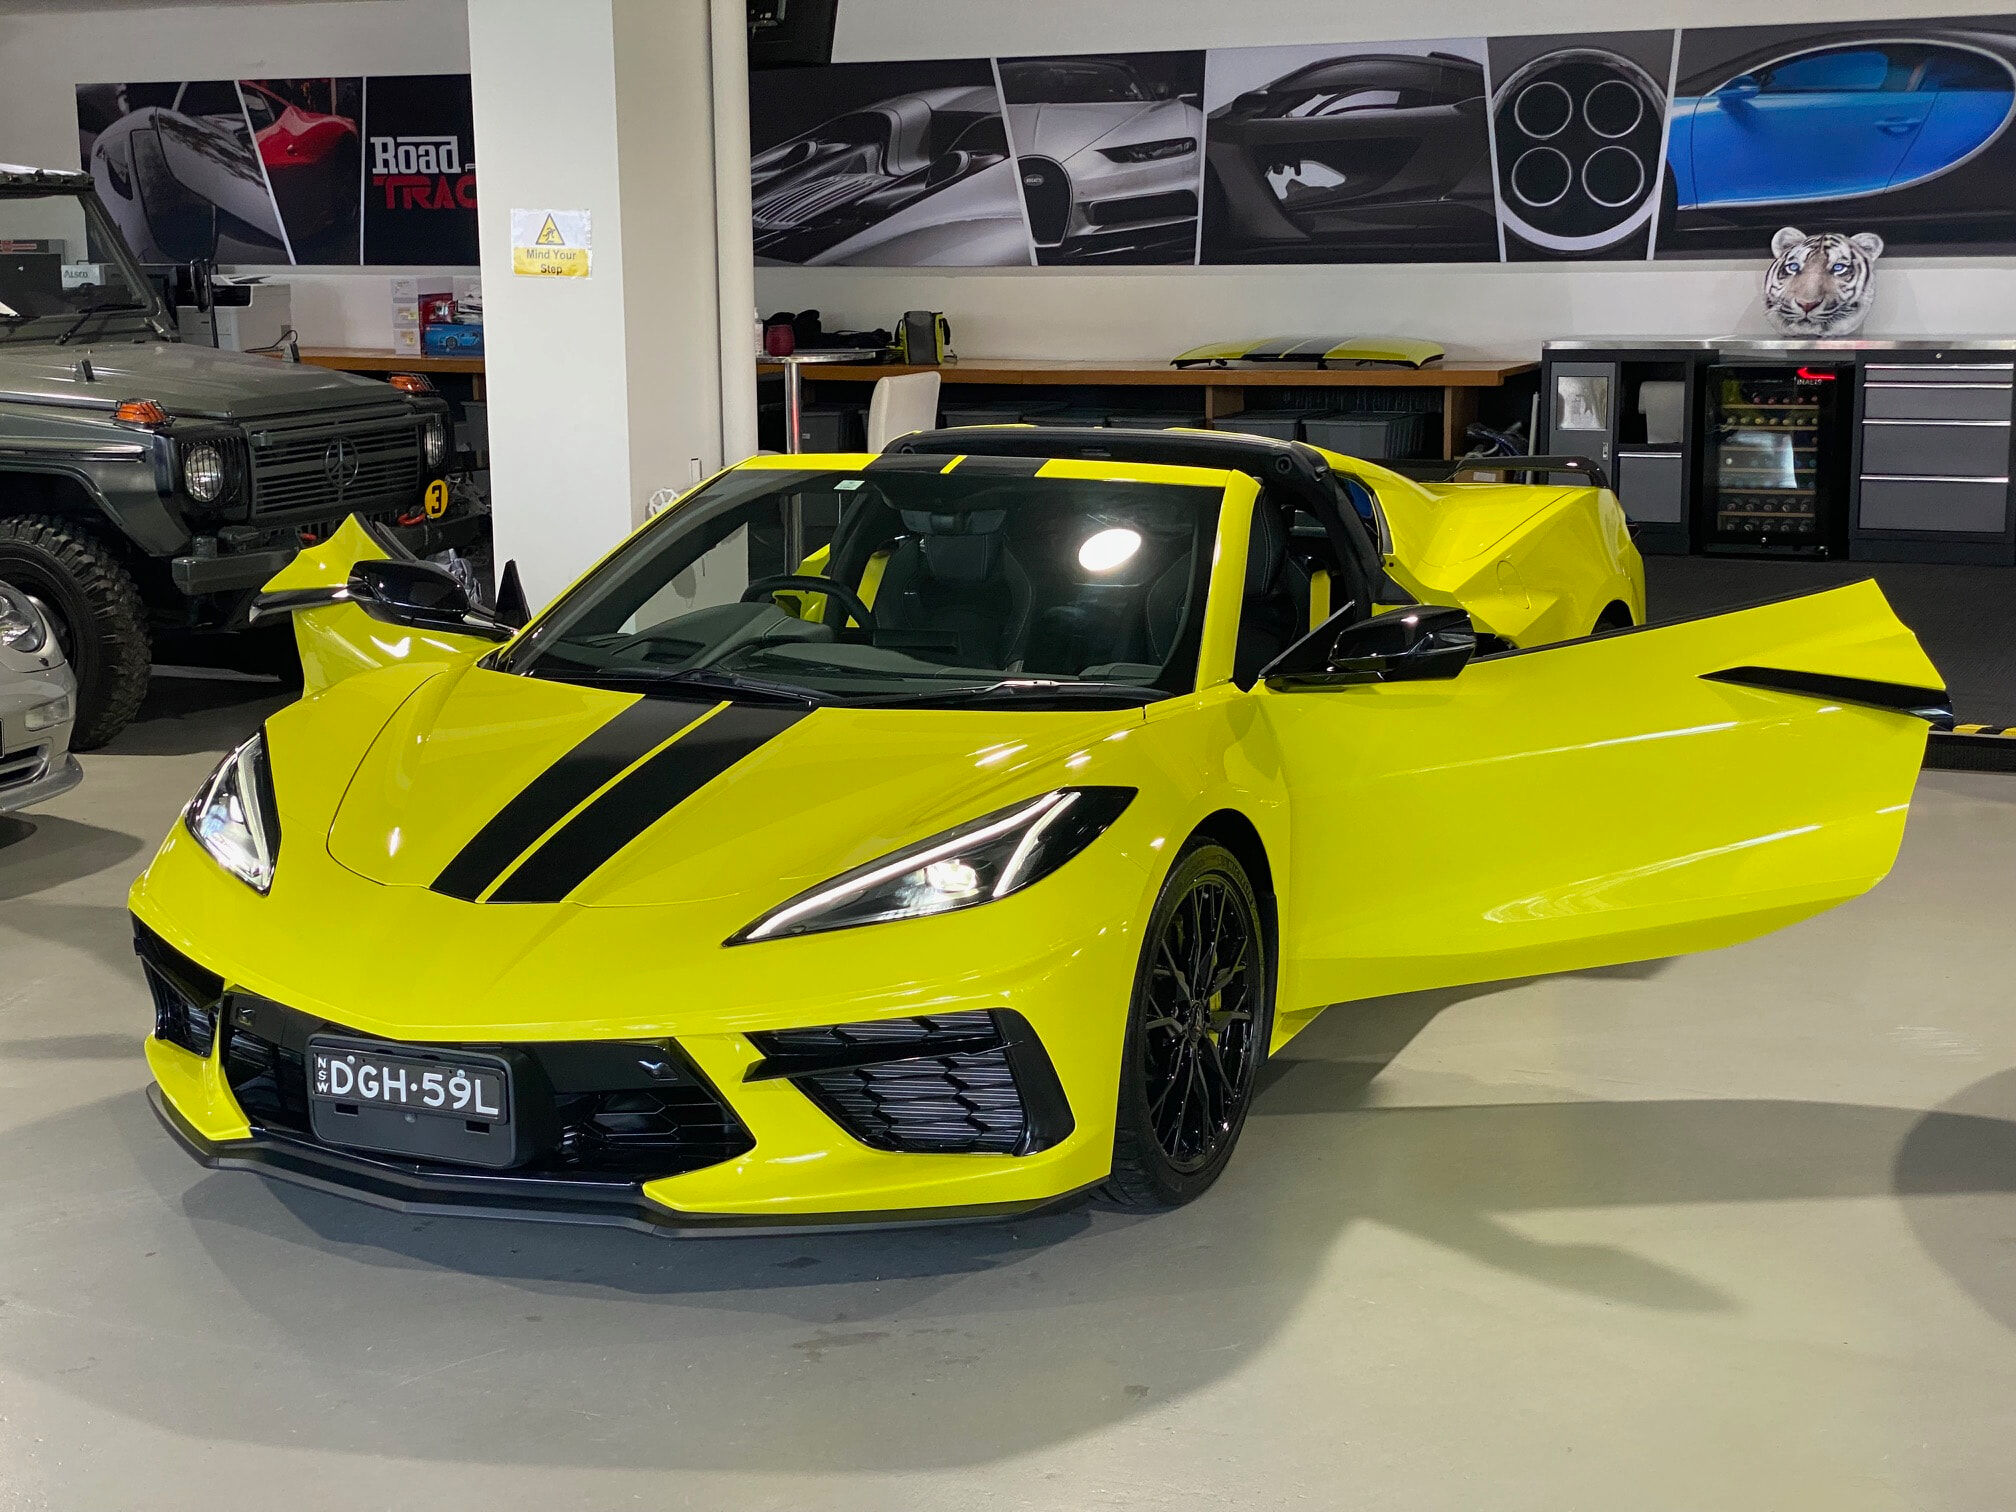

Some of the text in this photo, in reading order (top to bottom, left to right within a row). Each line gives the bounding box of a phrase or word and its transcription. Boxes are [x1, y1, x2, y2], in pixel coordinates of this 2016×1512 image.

[370, 136, 461, 174] Road
[526, 249, 576, 260] Mind Your
[540, 264, 563, 275] Step
[431, 484, 442, 514] 3
[317, 1056, 328, 1093] NSW
